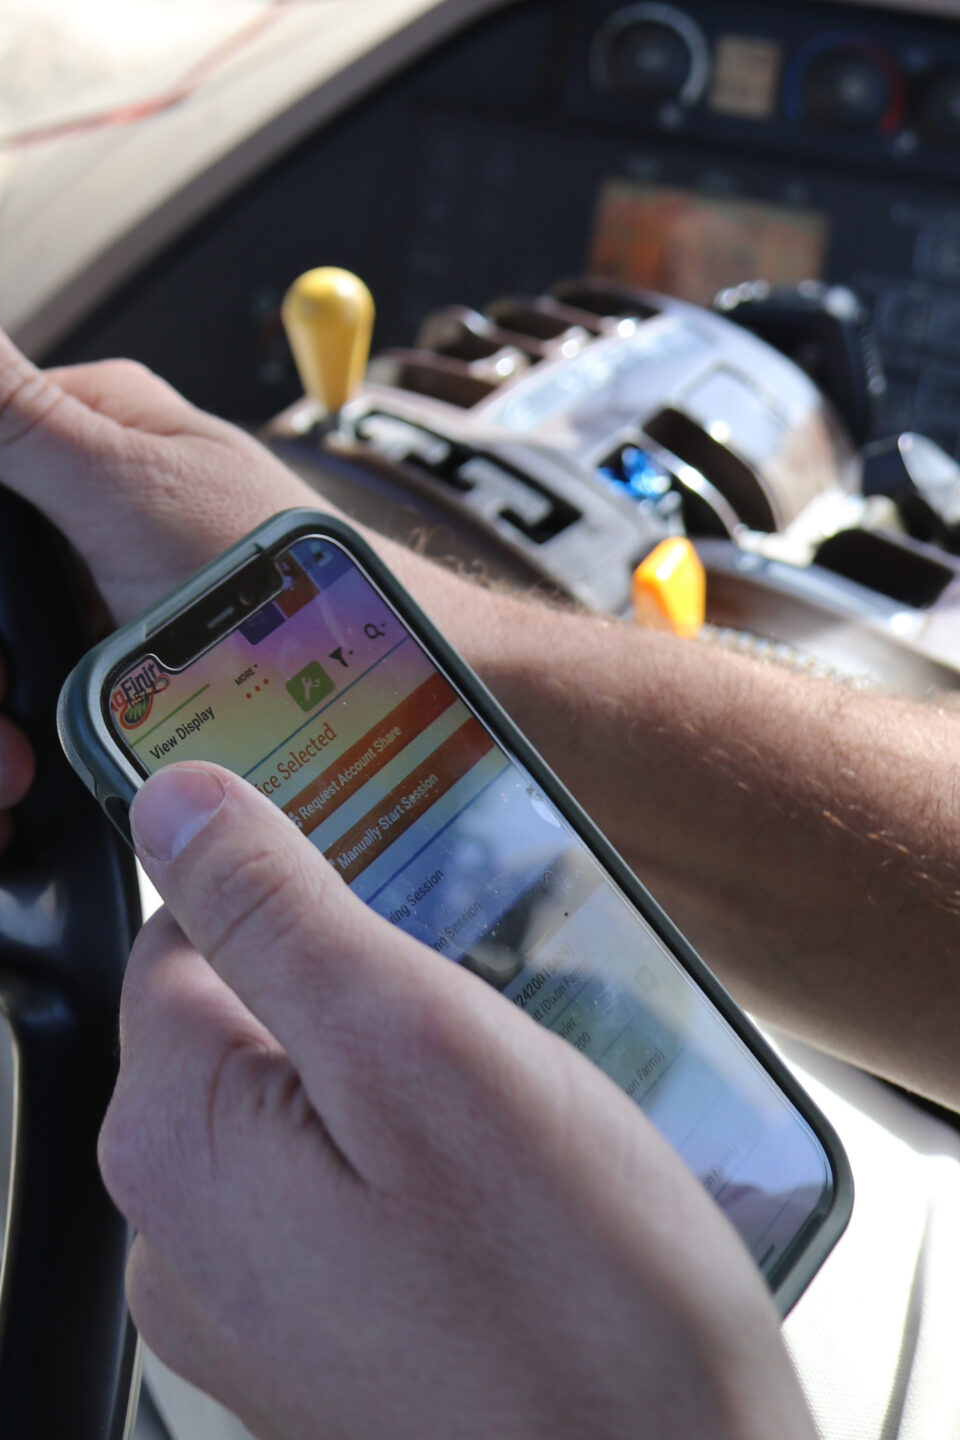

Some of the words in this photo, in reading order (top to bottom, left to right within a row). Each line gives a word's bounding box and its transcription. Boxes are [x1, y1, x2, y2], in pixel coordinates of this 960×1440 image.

[234, 667, 256, 687] MORE
[149, 736, 179, 760] View
[175, 706, 216, 741] Display
[276, 721, 338, 781] Selected
[298, 781, 340, 820] Request
[337, 748, 377, 786] Account
[373, 726, 402, 753] Share
[339, 825, 383, 869] Manually
[378, 804, 404, 830] Start
[400, 773, 439, 810] Session
[406, 869, 445, 906] Session
[445, 901, 483, 940] Session
